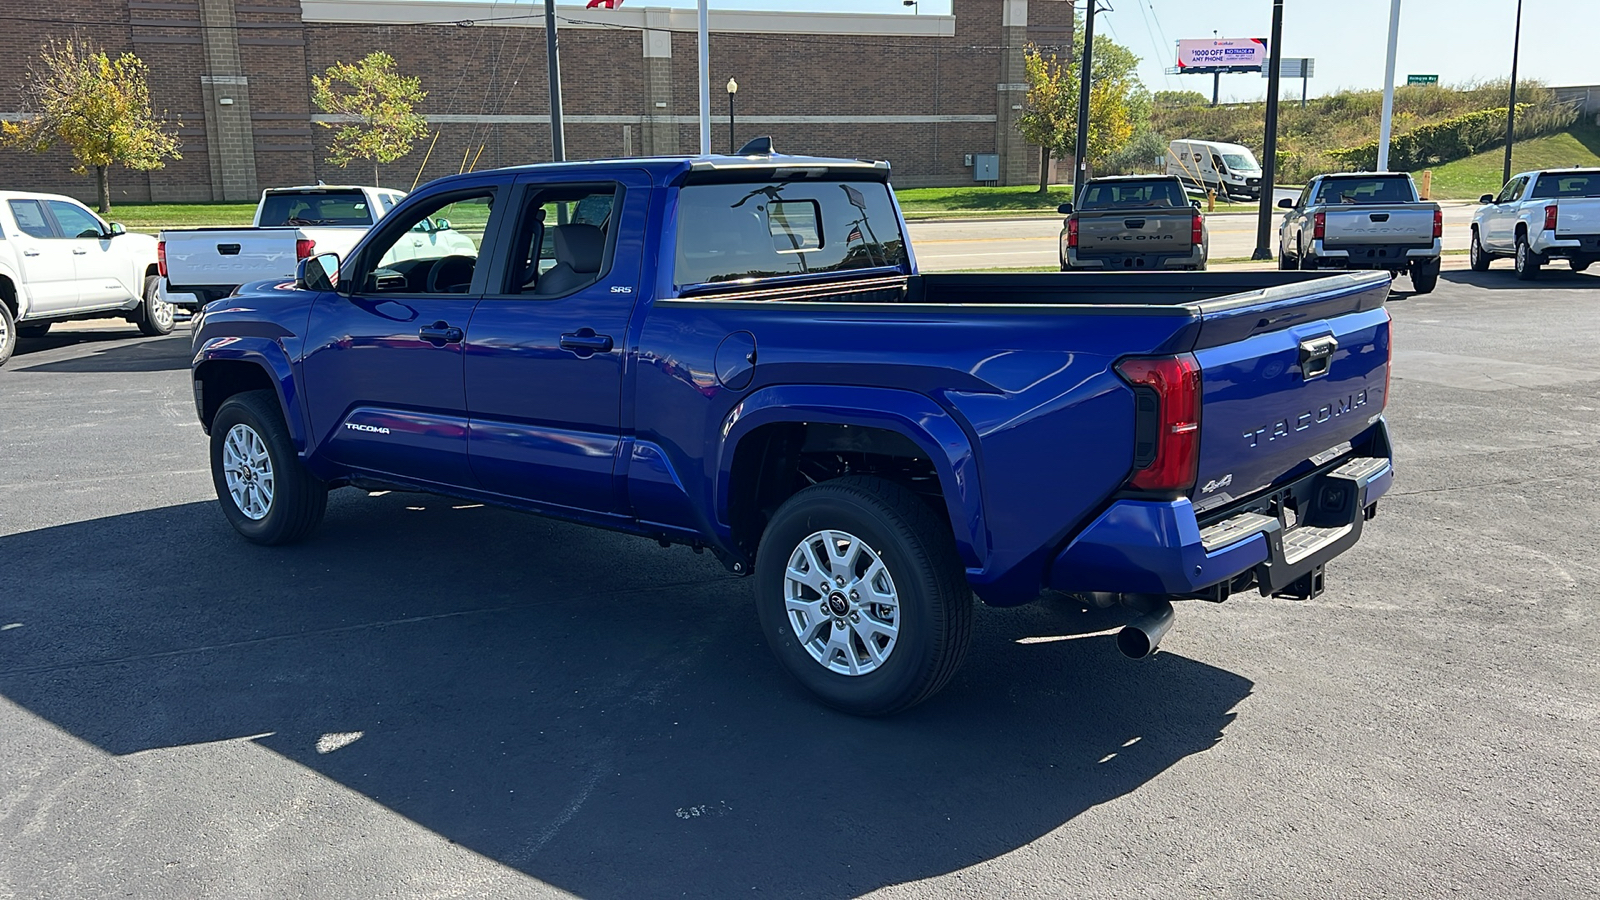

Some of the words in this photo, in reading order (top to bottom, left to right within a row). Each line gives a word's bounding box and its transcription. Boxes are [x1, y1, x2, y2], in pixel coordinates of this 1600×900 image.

[1097, 234, 1174, 242] TACOMA
[1242, 389, 1369, 448] TACOMA
[345, 422, 390, 435] TACOMA
